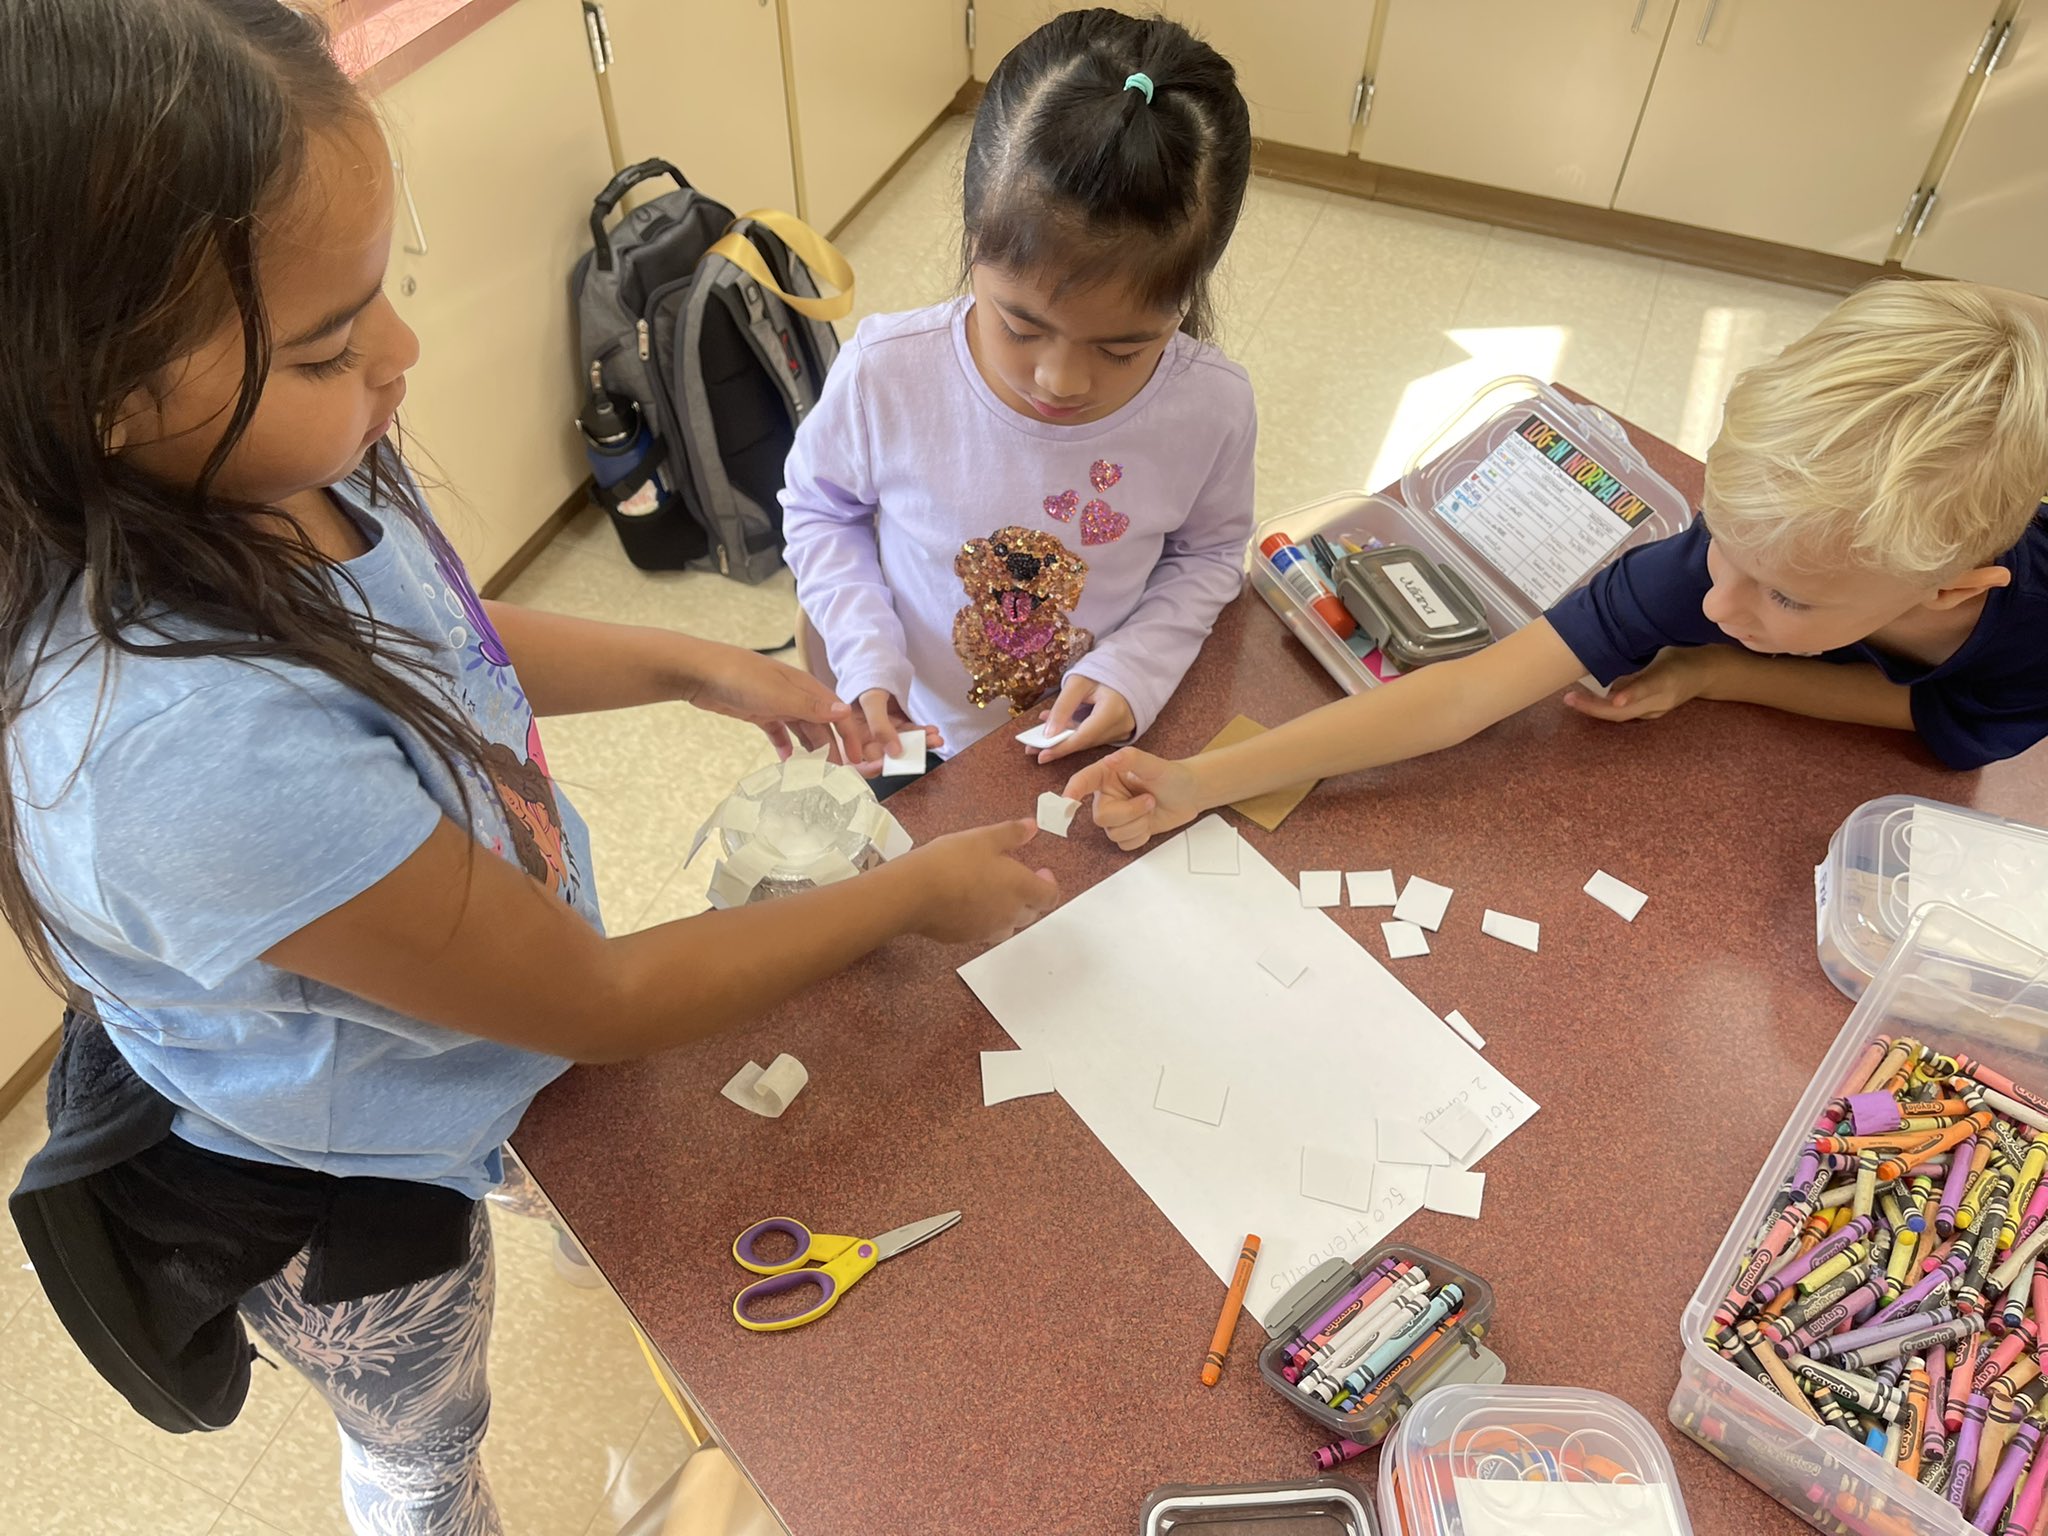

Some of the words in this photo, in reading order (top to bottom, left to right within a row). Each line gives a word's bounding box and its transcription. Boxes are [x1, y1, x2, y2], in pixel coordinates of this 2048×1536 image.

[1522, 420, 1572, 462] LOG-IN
[1559, 450, 1646, 523] INFORMATION
[1400, 577, 1436, 615] Juliana
[2014, 1084, 2048, 1111] Crayo
[1808, 1170, 1830, 1204] Crayola
[1739, 1252, 1772, 1290] Crayola
[1810, 1307, 1846, 1334] Crayola
[1903, 1331, 1951, 1353] Crayola
[1801, 1367, 1853, 1400] Crayola
[1972, 1362, 1999, 1391] Crayo
[1951, 1464, 1971, 1508] Crayol
